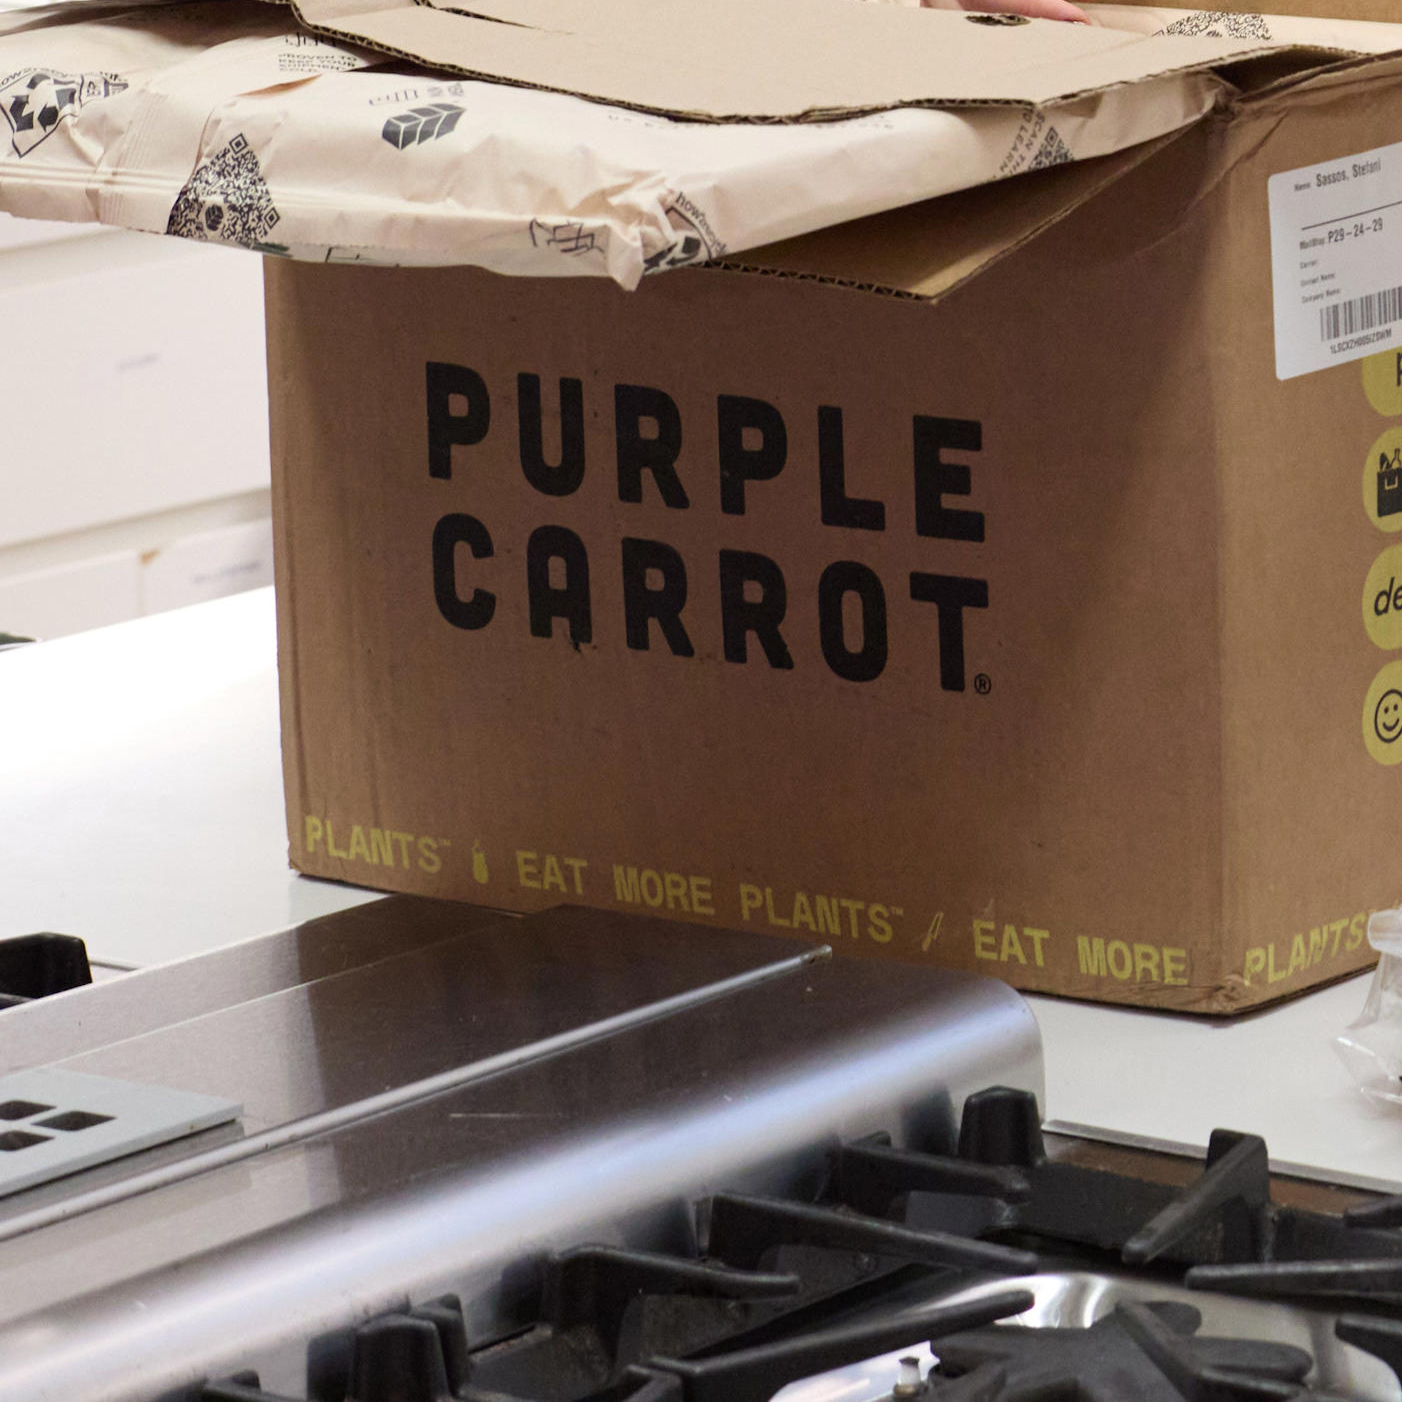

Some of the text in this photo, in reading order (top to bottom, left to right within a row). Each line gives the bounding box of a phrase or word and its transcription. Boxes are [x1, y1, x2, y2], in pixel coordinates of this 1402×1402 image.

[425, 361, 987, 545] PURPLE
[516, 849, 588, 896] EAT
[612, 863, 716, 917] MORE
[972, 918, 1051, 968] EAT
[1077, 934, 1190, 988] MORE
